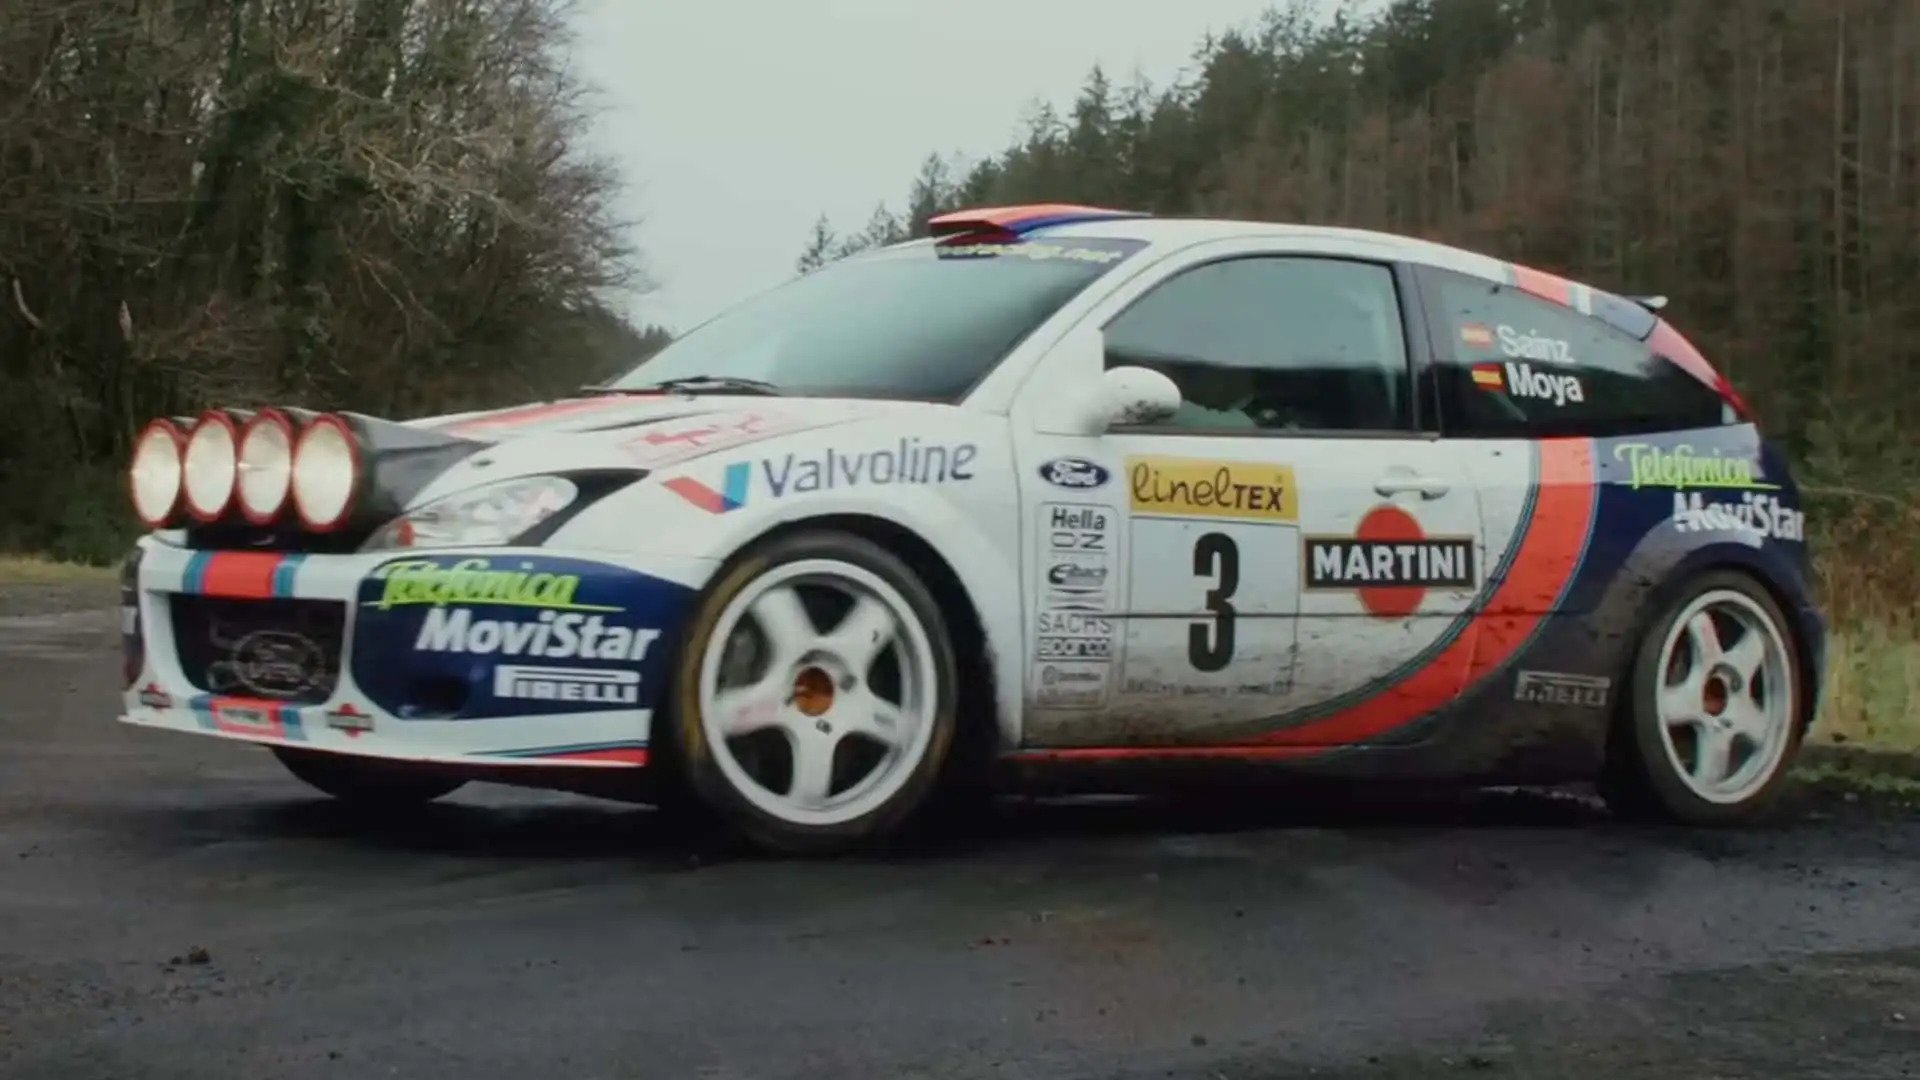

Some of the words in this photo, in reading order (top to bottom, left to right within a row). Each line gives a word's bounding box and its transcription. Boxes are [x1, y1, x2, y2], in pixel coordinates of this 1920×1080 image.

[1497, 324, 1576, 364] Sainz
[1505, 361, 1584, 407] Moya
[762, 436, 979, 498] Valvoline
[1050, 459, 1098, 486] Ford
[1051, 506, 1107, 530] Hella
[1672, 490, 1805, 544] MoviStar
[1313, 543, 1467, 581] MARTINI
[1039, 612, 1112, 634] SACHS
[1188, 532, 1240, 673] 3
[413, 606, 663, 662] MoviStar
[493, 663, 642, 704] PIRELLI
